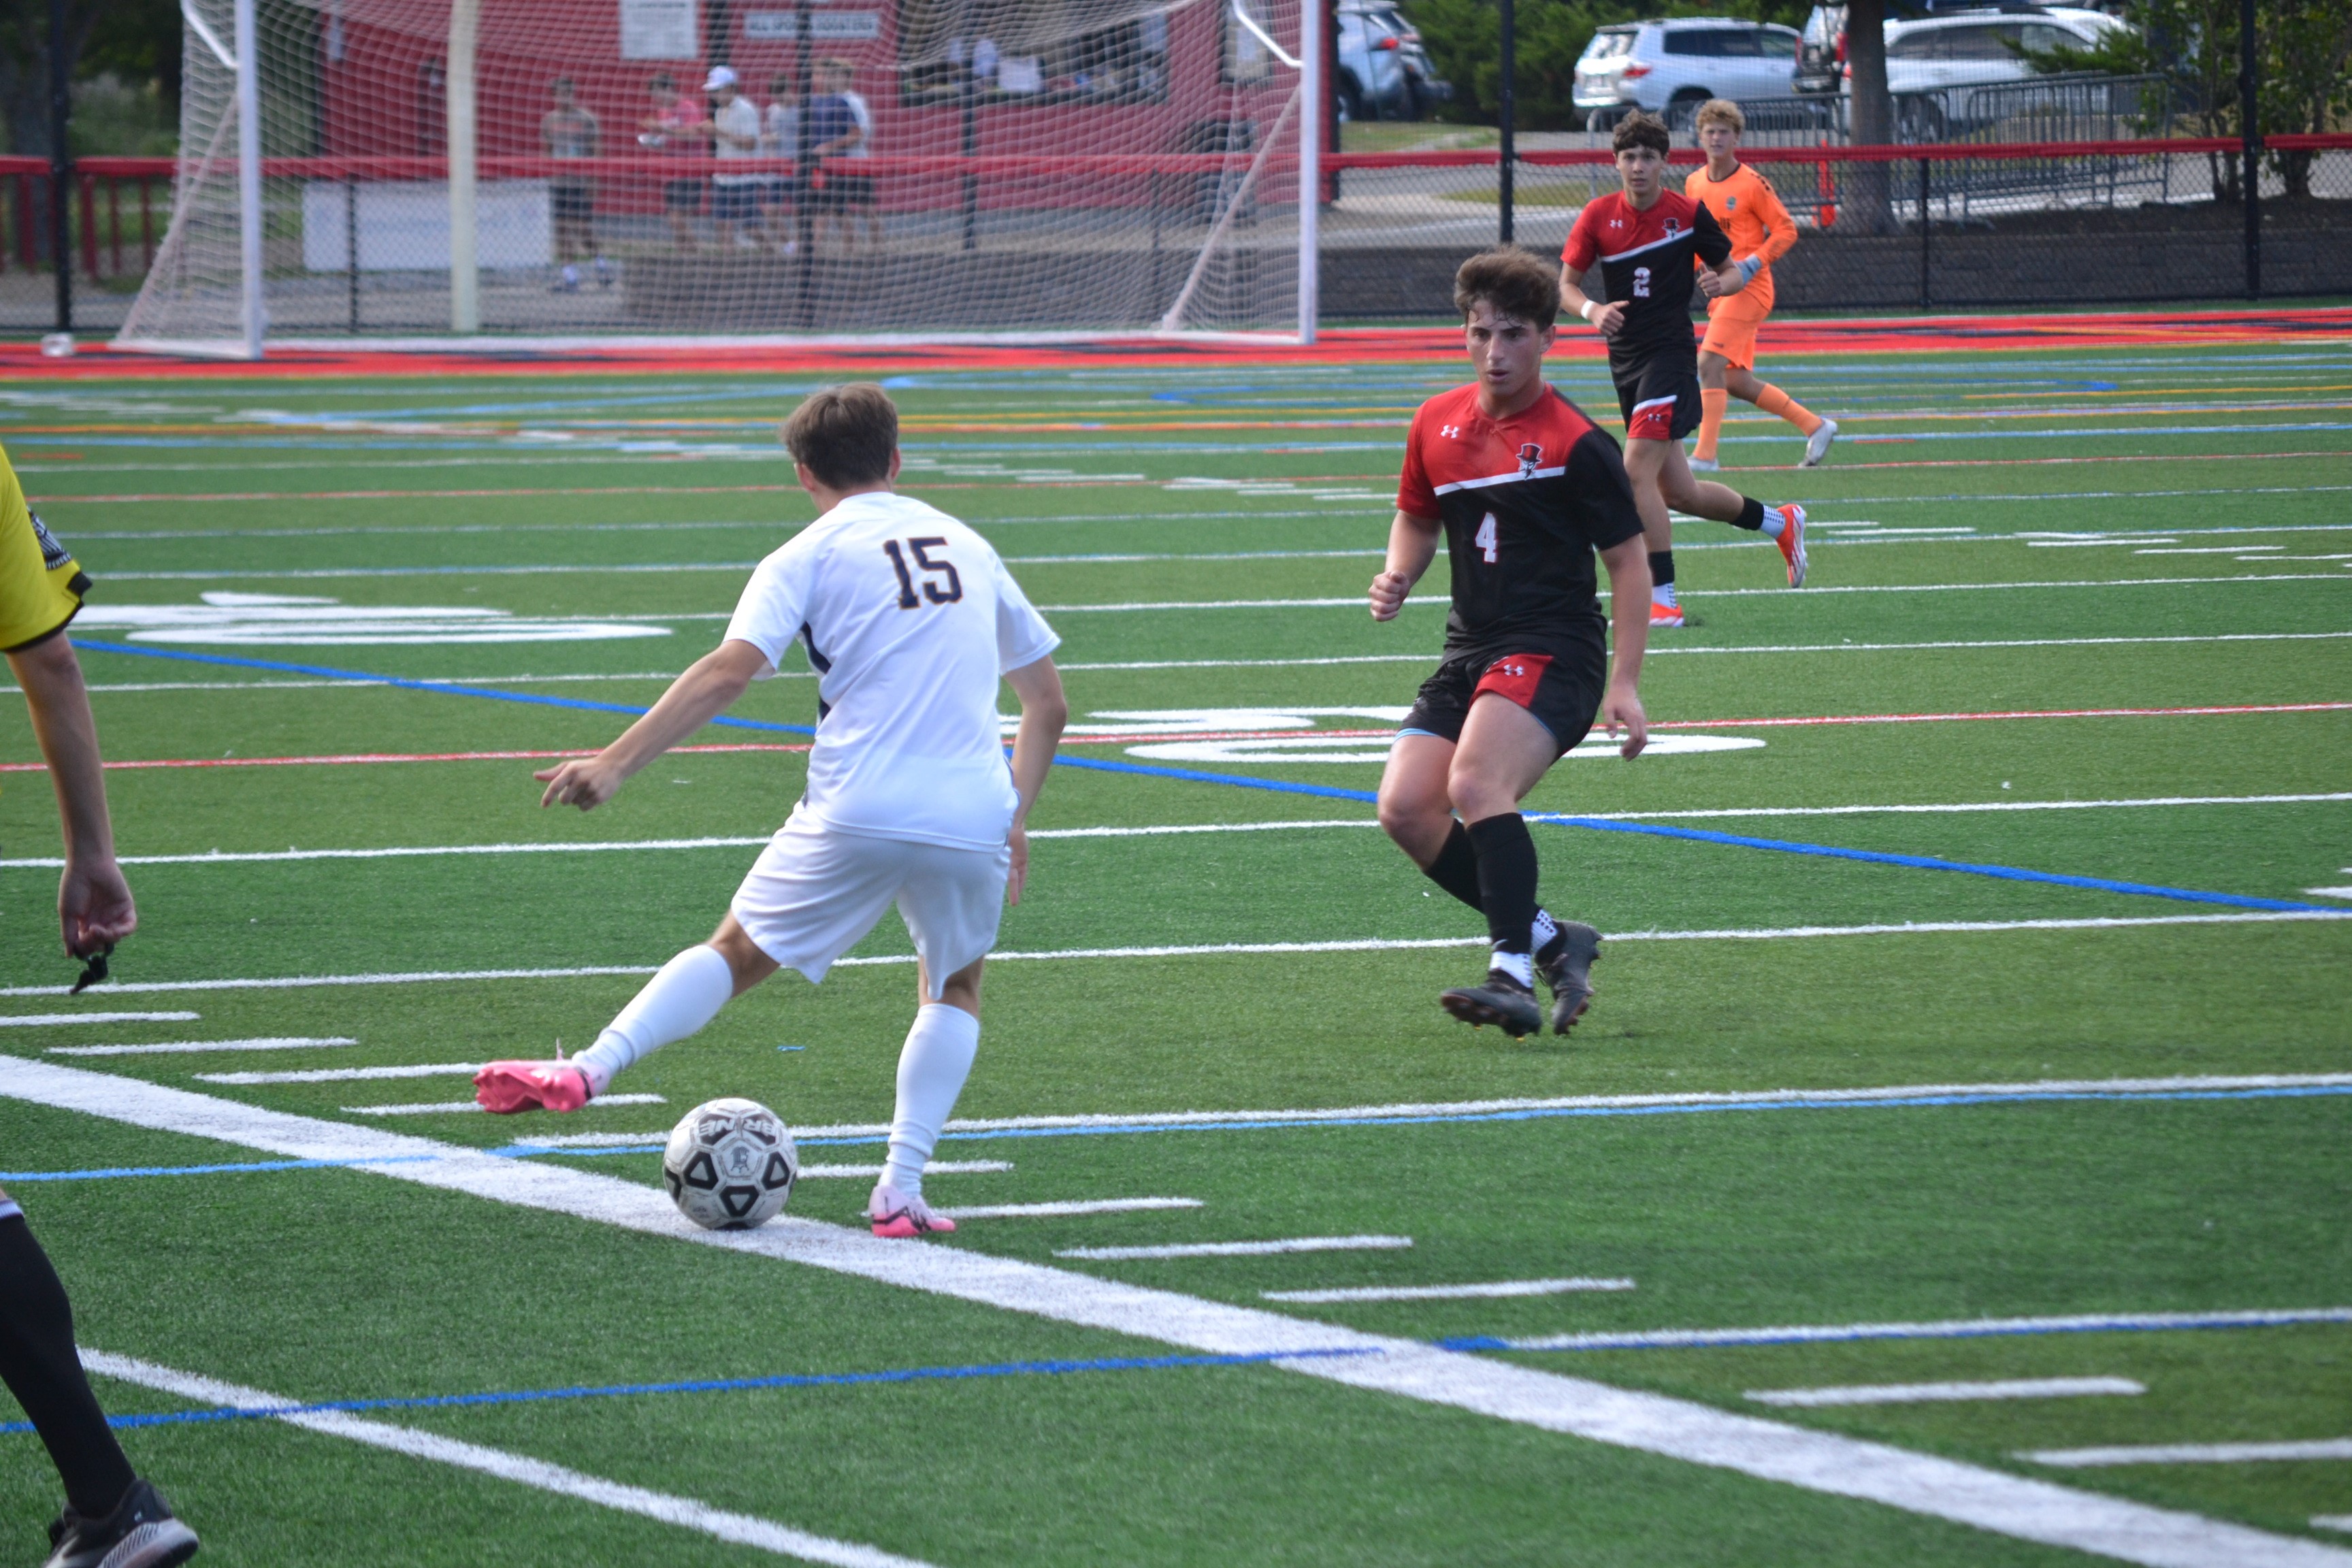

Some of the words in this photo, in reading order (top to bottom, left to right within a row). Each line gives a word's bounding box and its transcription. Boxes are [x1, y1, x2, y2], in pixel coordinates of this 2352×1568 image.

[1632, 266, 1652, 298] 2
[1475, 511, 1499, 564] 4
[882, 536, 963, 610] 15
